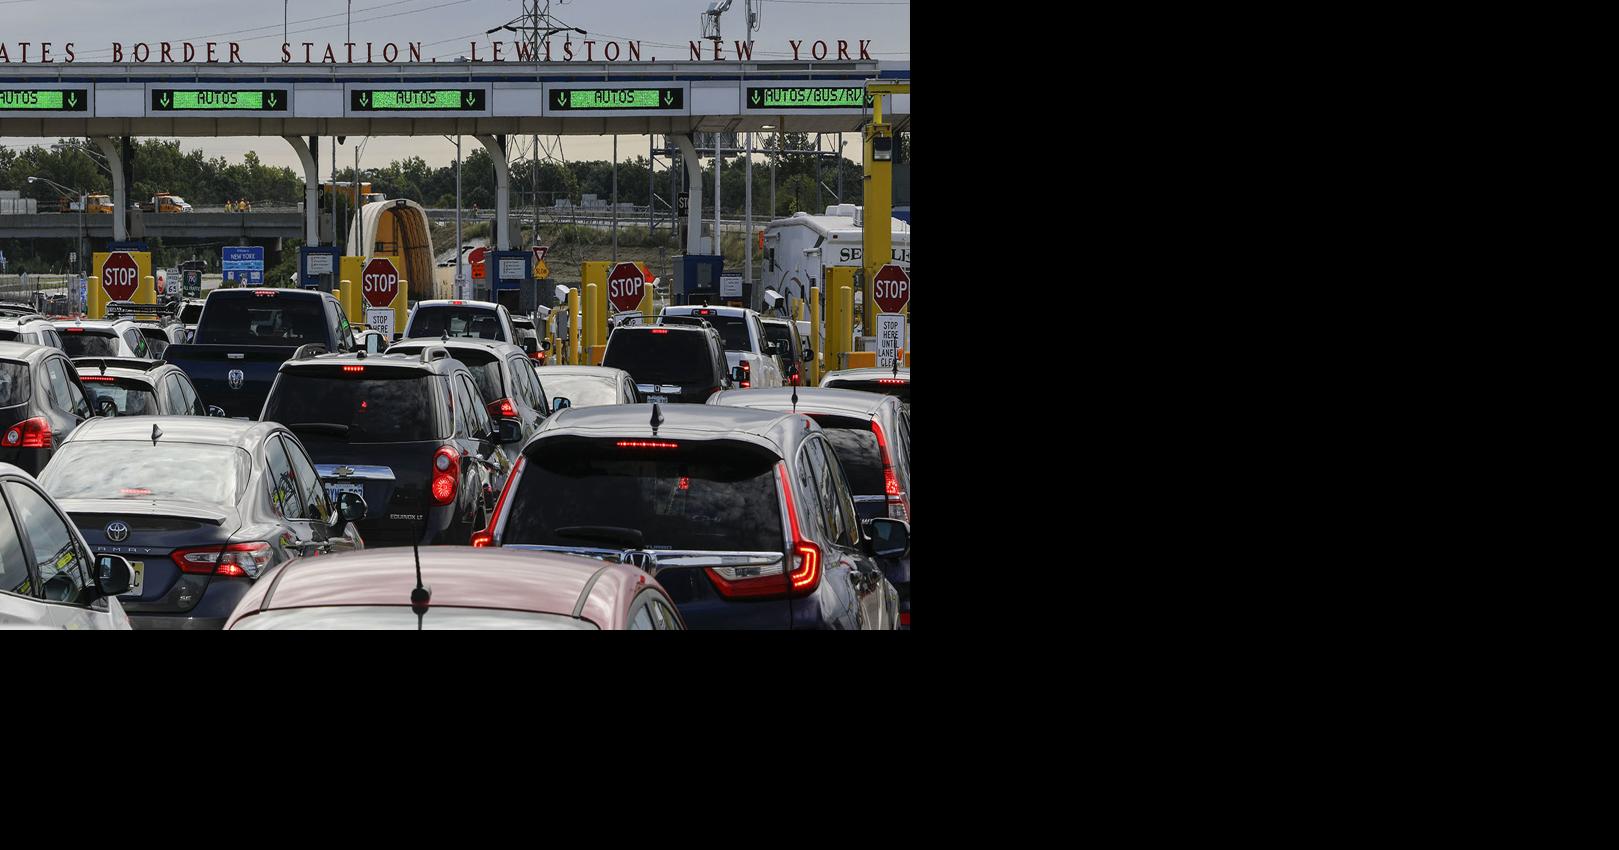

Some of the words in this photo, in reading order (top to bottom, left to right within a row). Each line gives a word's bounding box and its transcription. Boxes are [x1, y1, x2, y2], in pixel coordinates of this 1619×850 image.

[0, 42, 75, 63] ATES
[112, 42, 243, 63] BORDER
[689, 40, 755, 61] NEW
[789, 40, 872, 61] YORK
[0, 91, 38, 104] AUTOS
[197, 91, 238, 104] AUTOS
[396, 91, 437, 104] AUTOS
[594, 91, 635, 104] AUTOS
[765, 89, 863, 102] AUTOS/BUS/RV
[105, 267, 136, 286] STOP
[365, 274, 396, 292] STOP
[611, 277, 642, 298] STOP
[876, 280, 907, 299] STOP
[373, 315, 388, 324] STOP
[883, 321, 899, 330] STOP
[883, 330, 899, 339] HERE
[881, 339, 900, 348] UNTL
[878, 348, 893, 357] LANE
[880, 358, 898, 367] CLEA
